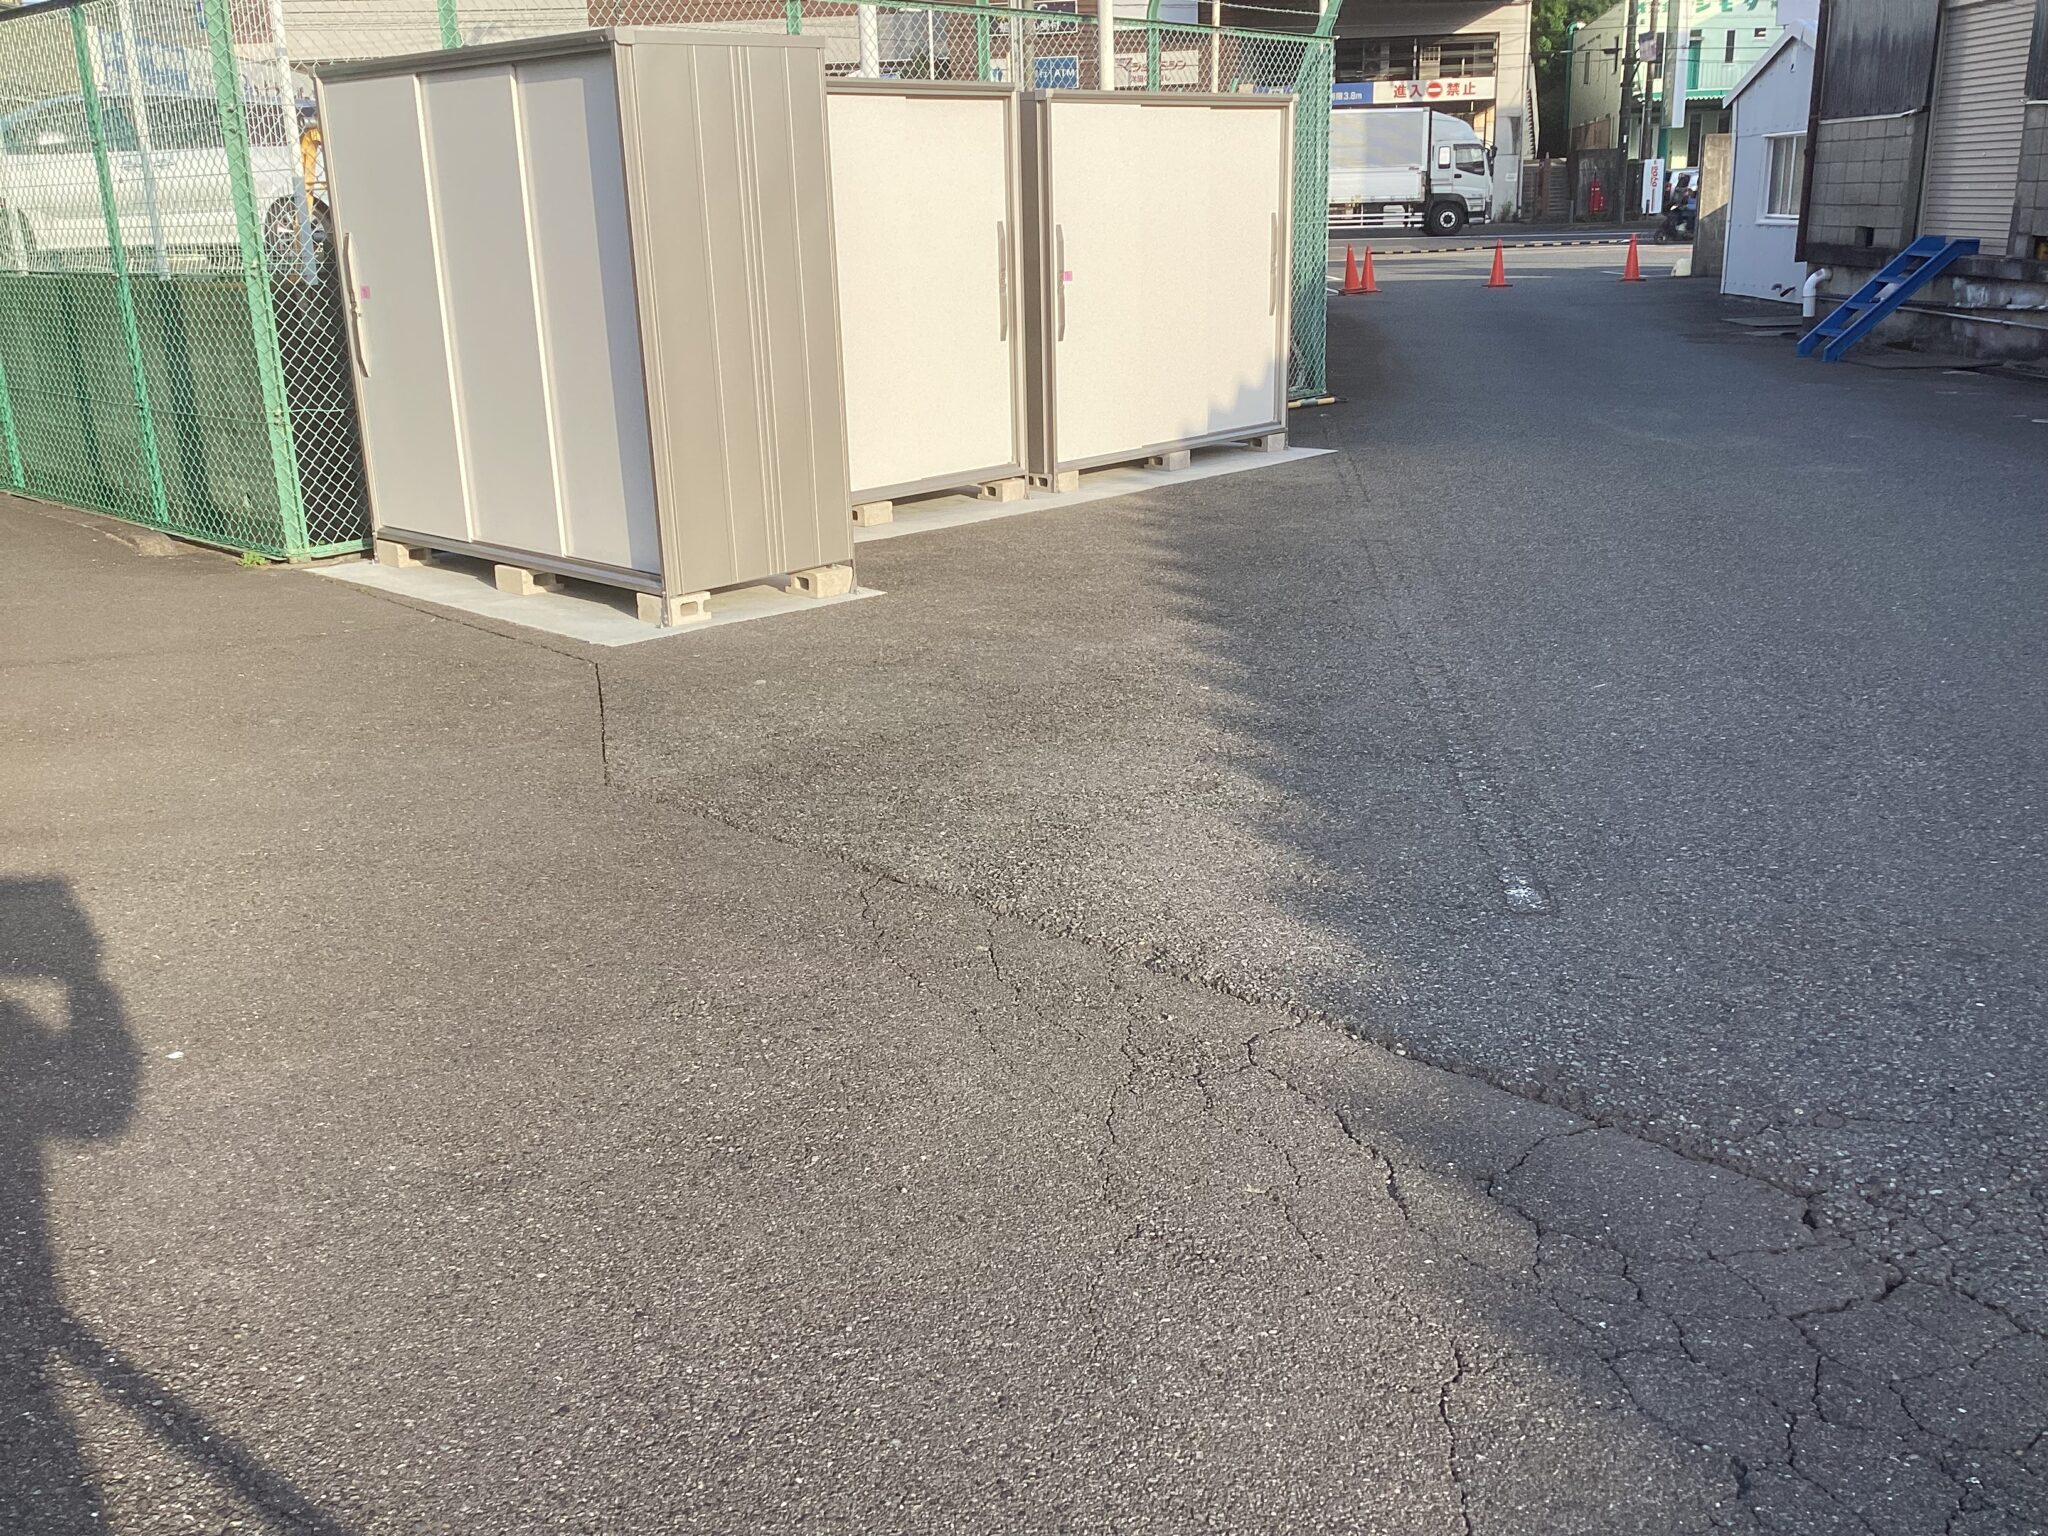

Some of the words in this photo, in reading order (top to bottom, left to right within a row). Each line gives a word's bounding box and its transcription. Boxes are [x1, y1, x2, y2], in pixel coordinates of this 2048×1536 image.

[1054, 68, 1075, 77] ATM
[1393, 84, 1423, 98] 進入
[1446, 82, 1477, 96] 禁止
